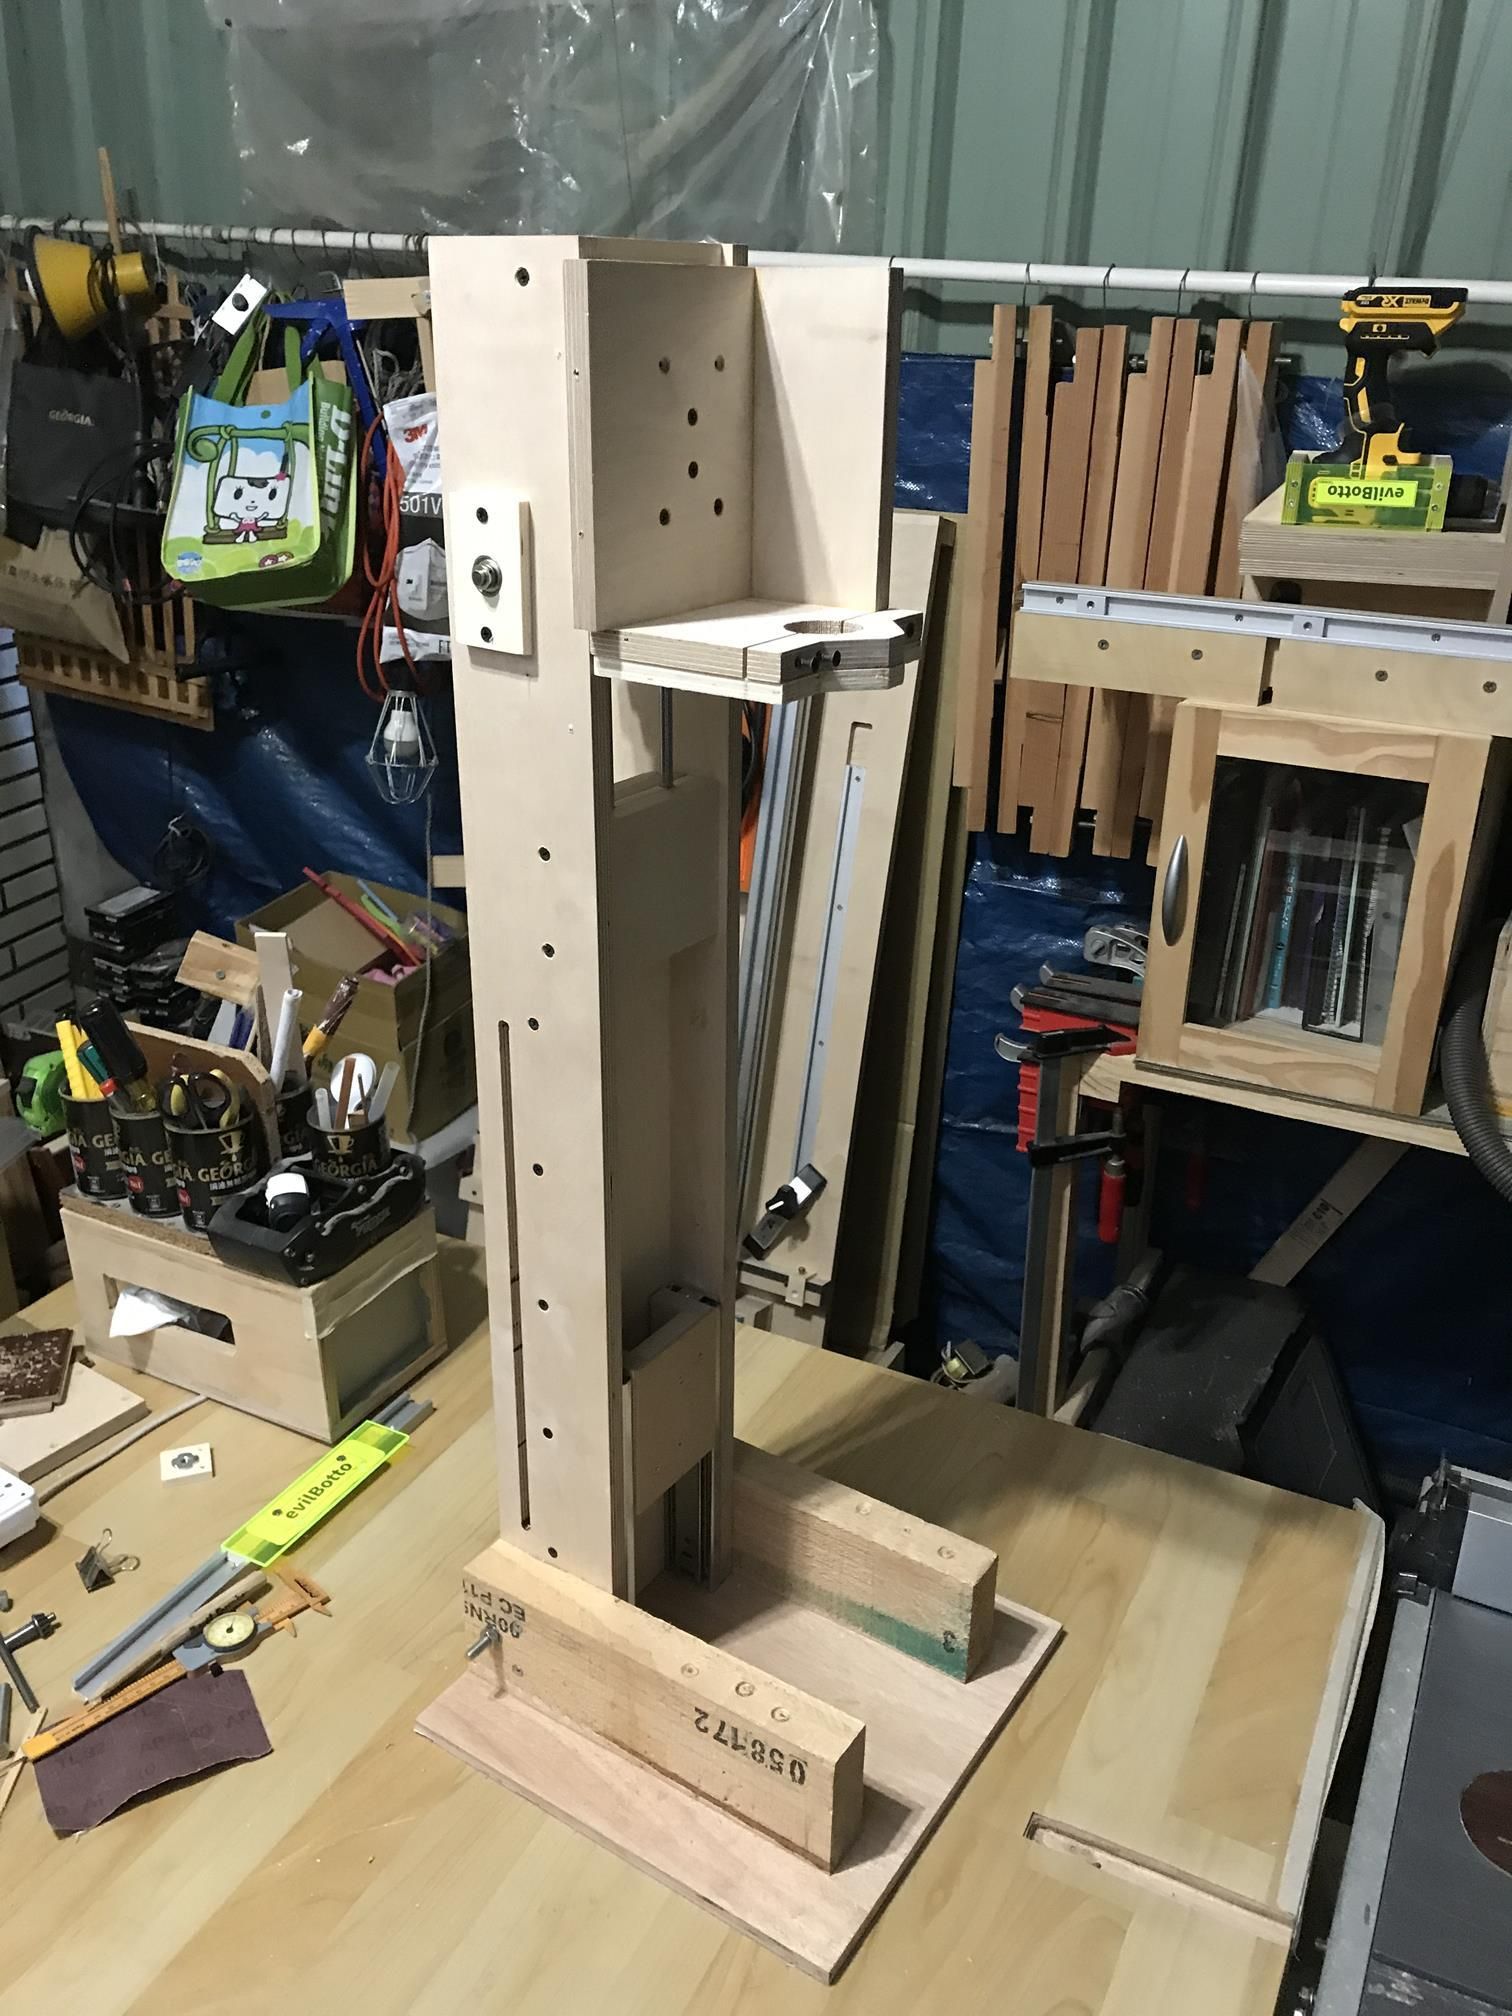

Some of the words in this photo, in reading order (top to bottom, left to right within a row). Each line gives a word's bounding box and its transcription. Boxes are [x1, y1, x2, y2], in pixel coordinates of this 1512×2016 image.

[403, 423, 429, 443] 3M
[1327, 485, 1405, 501] evilBotto
[286, 1463, 352, 1519] evilBotto
